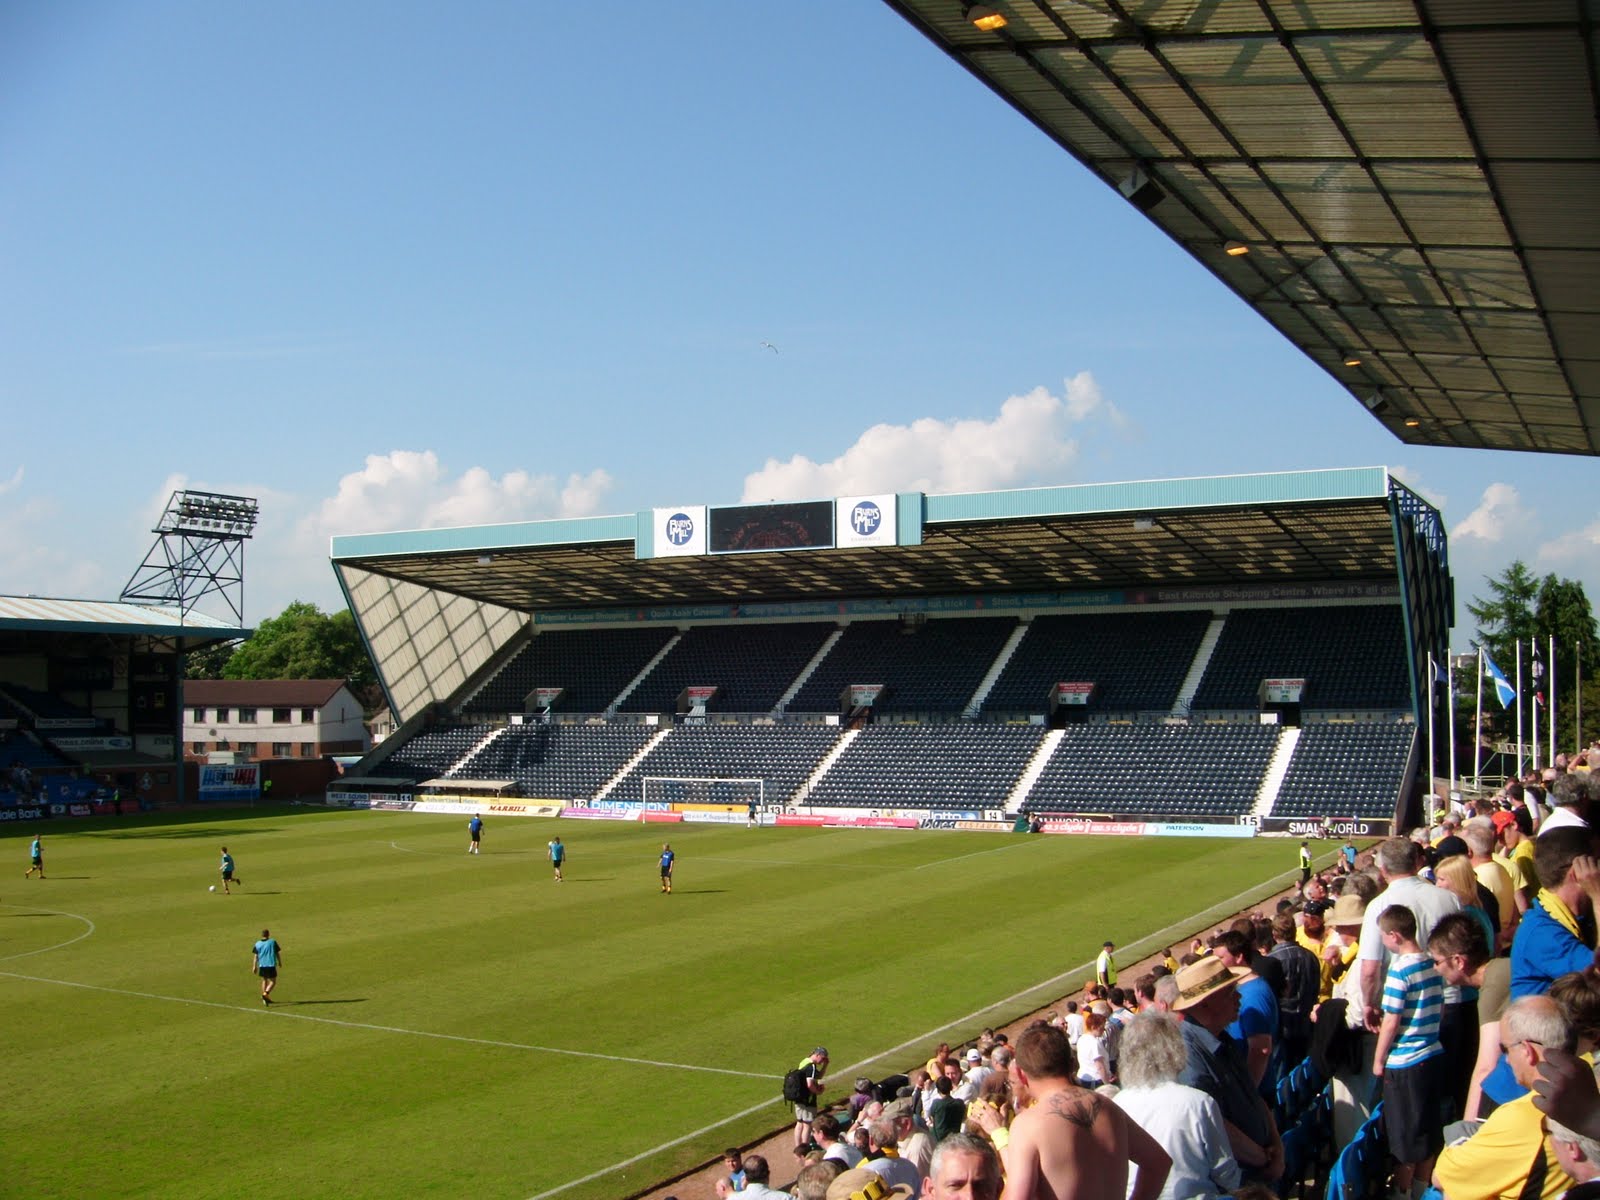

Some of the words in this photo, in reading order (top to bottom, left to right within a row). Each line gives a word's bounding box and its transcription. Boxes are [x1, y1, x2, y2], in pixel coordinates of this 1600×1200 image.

[1158, 591, 1180, 600] East
[1182, 590, 1220, 599] Kilbride
[1222, 589, 1270, 599] Shopping
[1311, 586, 1345, 596] Where
[575, 800, 587, 808] 12
[591, 800, 669, 811] DIMENSON
[18, 808, 42, 819] Bank
[488, 805, 528, 813] MARBILL
[770, 806, 781, 815] 13
[989, 812, 998, 821] 14
[1242, 816, 1258, 826] 15
[1165, 824, 1205, 832] PATERSON
